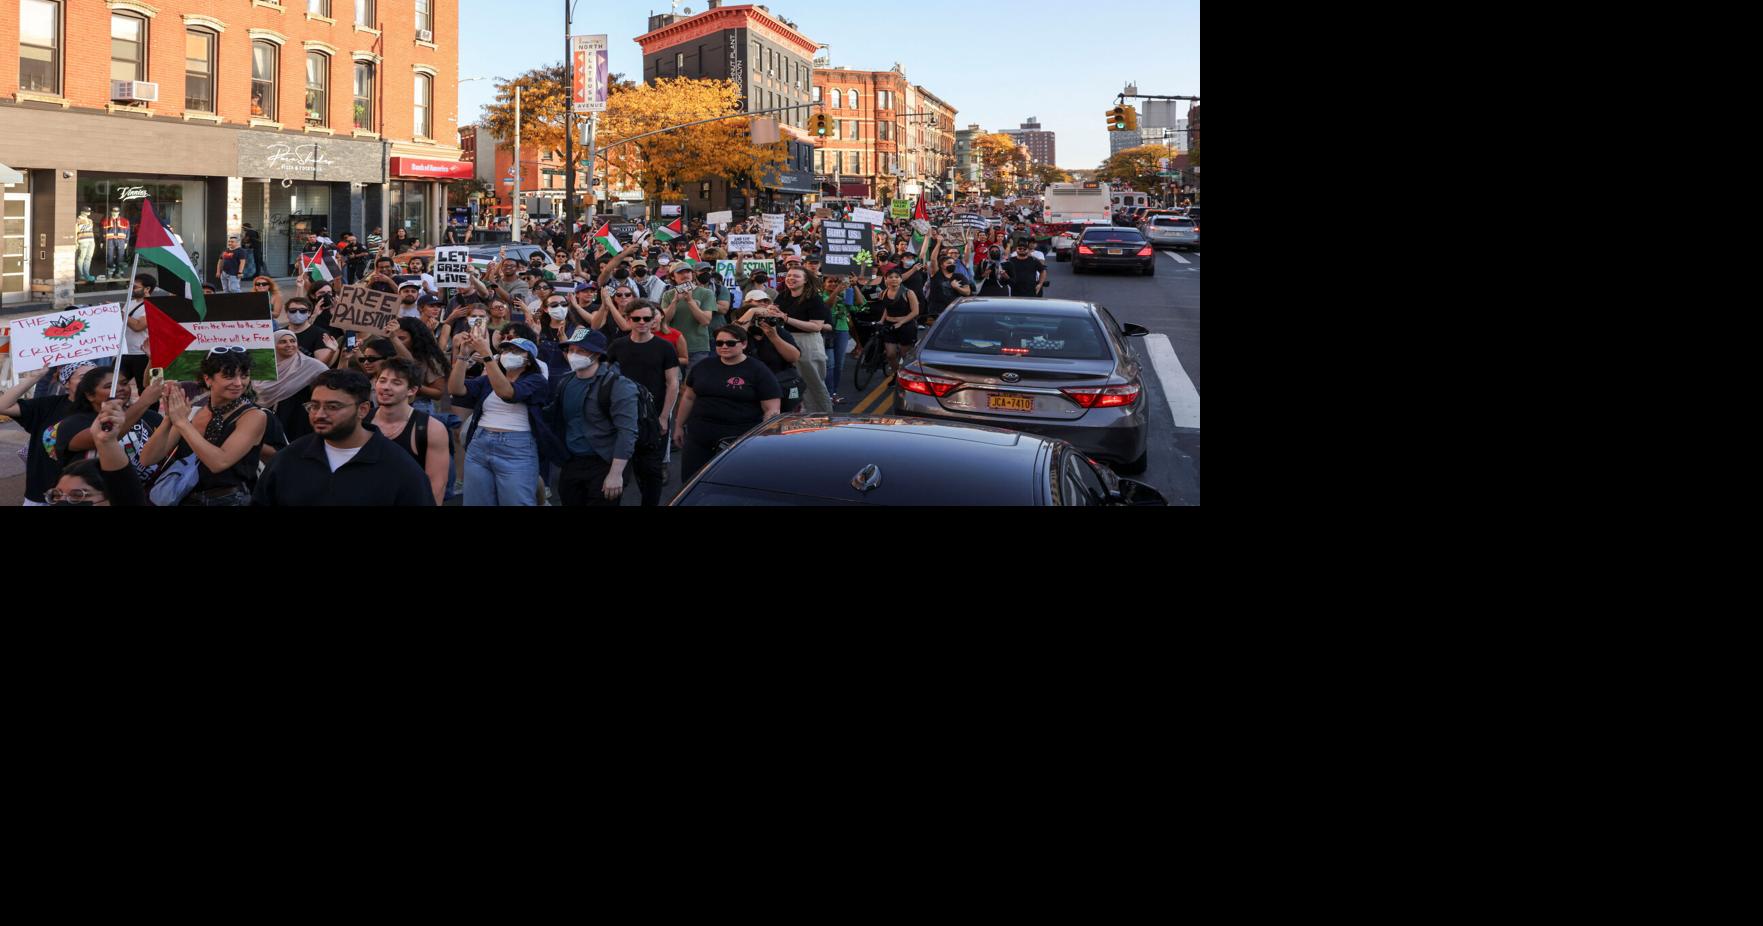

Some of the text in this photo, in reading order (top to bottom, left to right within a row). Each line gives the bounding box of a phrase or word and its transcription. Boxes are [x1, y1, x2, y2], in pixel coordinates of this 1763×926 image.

[411, 163, 424, 171] Bank
[438, 251, 468, 262] LET
[437, 263, 468, 272] GAZA
[341, 286, 398, 313] FREE
[14, 305, 120, 329] THE WORLD
[196, 333, 228, 344] Palestine
[229, 334, 240, 343] will
[253, 333, 270, 342] Free
[18, 333, 117, 358] CRIES WITH
[991, 399, 1031, 409] JCA 7410
